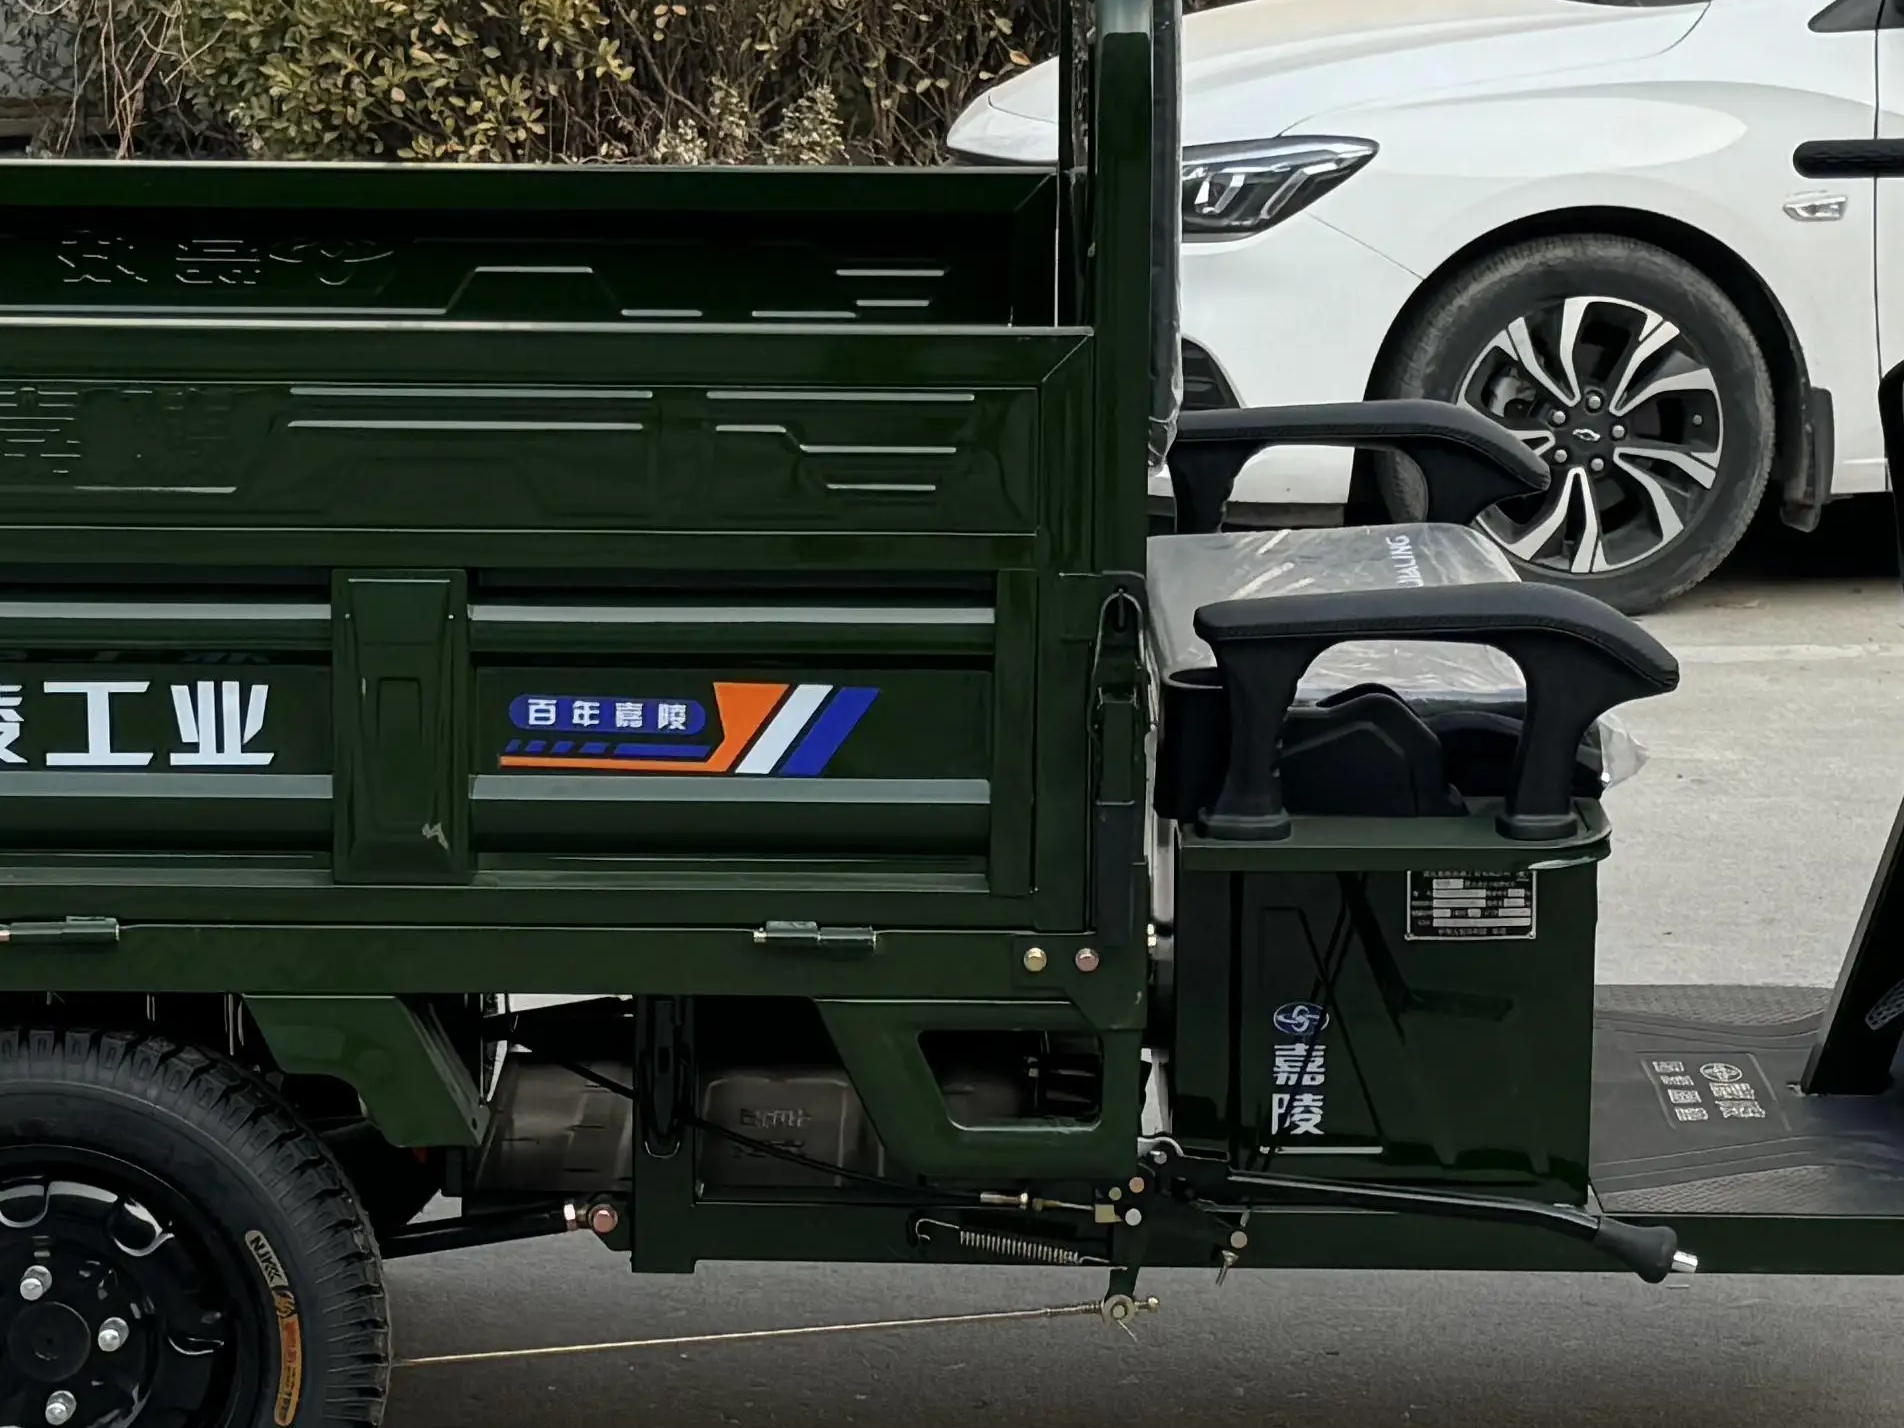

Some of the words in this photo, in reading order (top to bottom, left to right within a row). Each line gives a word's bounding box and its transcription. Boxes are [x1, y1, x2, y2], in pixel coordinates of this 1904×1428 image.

[527, 699, 687, 730] 百年嘉陵
[1270, 1043, 1327, 1136] 嘉陵
